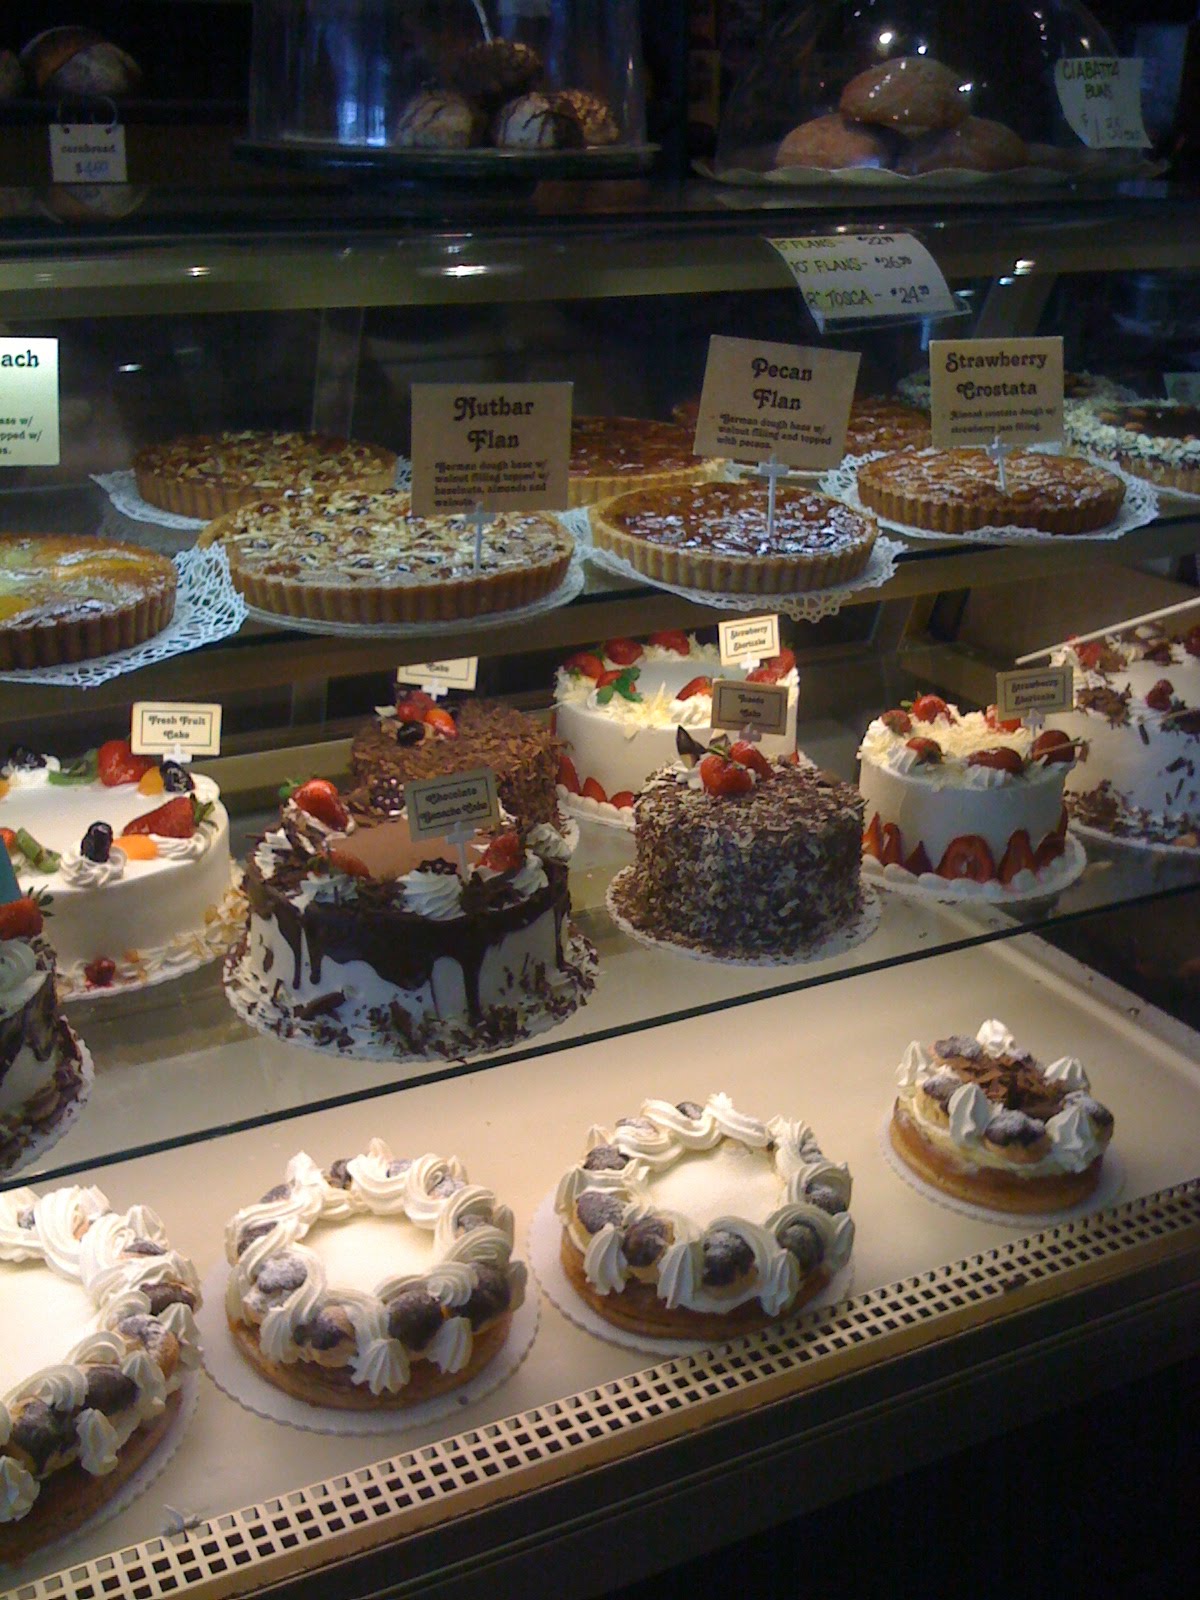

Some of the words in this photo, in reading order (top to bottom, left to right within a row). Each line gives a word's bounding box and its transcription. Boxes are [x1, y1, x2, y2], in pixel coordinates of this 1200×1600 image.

[825, 289, 873, 308] TOSCA
[0, 349, 39, 368] ach
[945, 351, 1048, 373] Strawberry
[751, 357, 813, 382] Pecan
[752, 388, 802, 411] Flan
[956, 381, 1038, 400] Crostata
[453, 396, 535, 421] Nutbar
[19, 416, 33, 428] w/
[760, 418, 788, 430] dough
[28, 430, 43, 443] w/
[467, 429, 520, 452] Flan
[717, 436, 737, 445] with
[718, 426, 749, 436] walnut
[752, 427, 779, 440] filling
[781, 433, 798, 441] and
[801, 434, 832, 445] topped
[479, 460, 509, 471] dough
[529, 482, 546, 492] and
[148, 715, 178, 726] Fresh
[179, 715, 206, 726] Fruit
[163, 730, 190, 740] Cake
[425, 787, 478, 805] Chocolate
[462, 801, 488, 814] Cake
